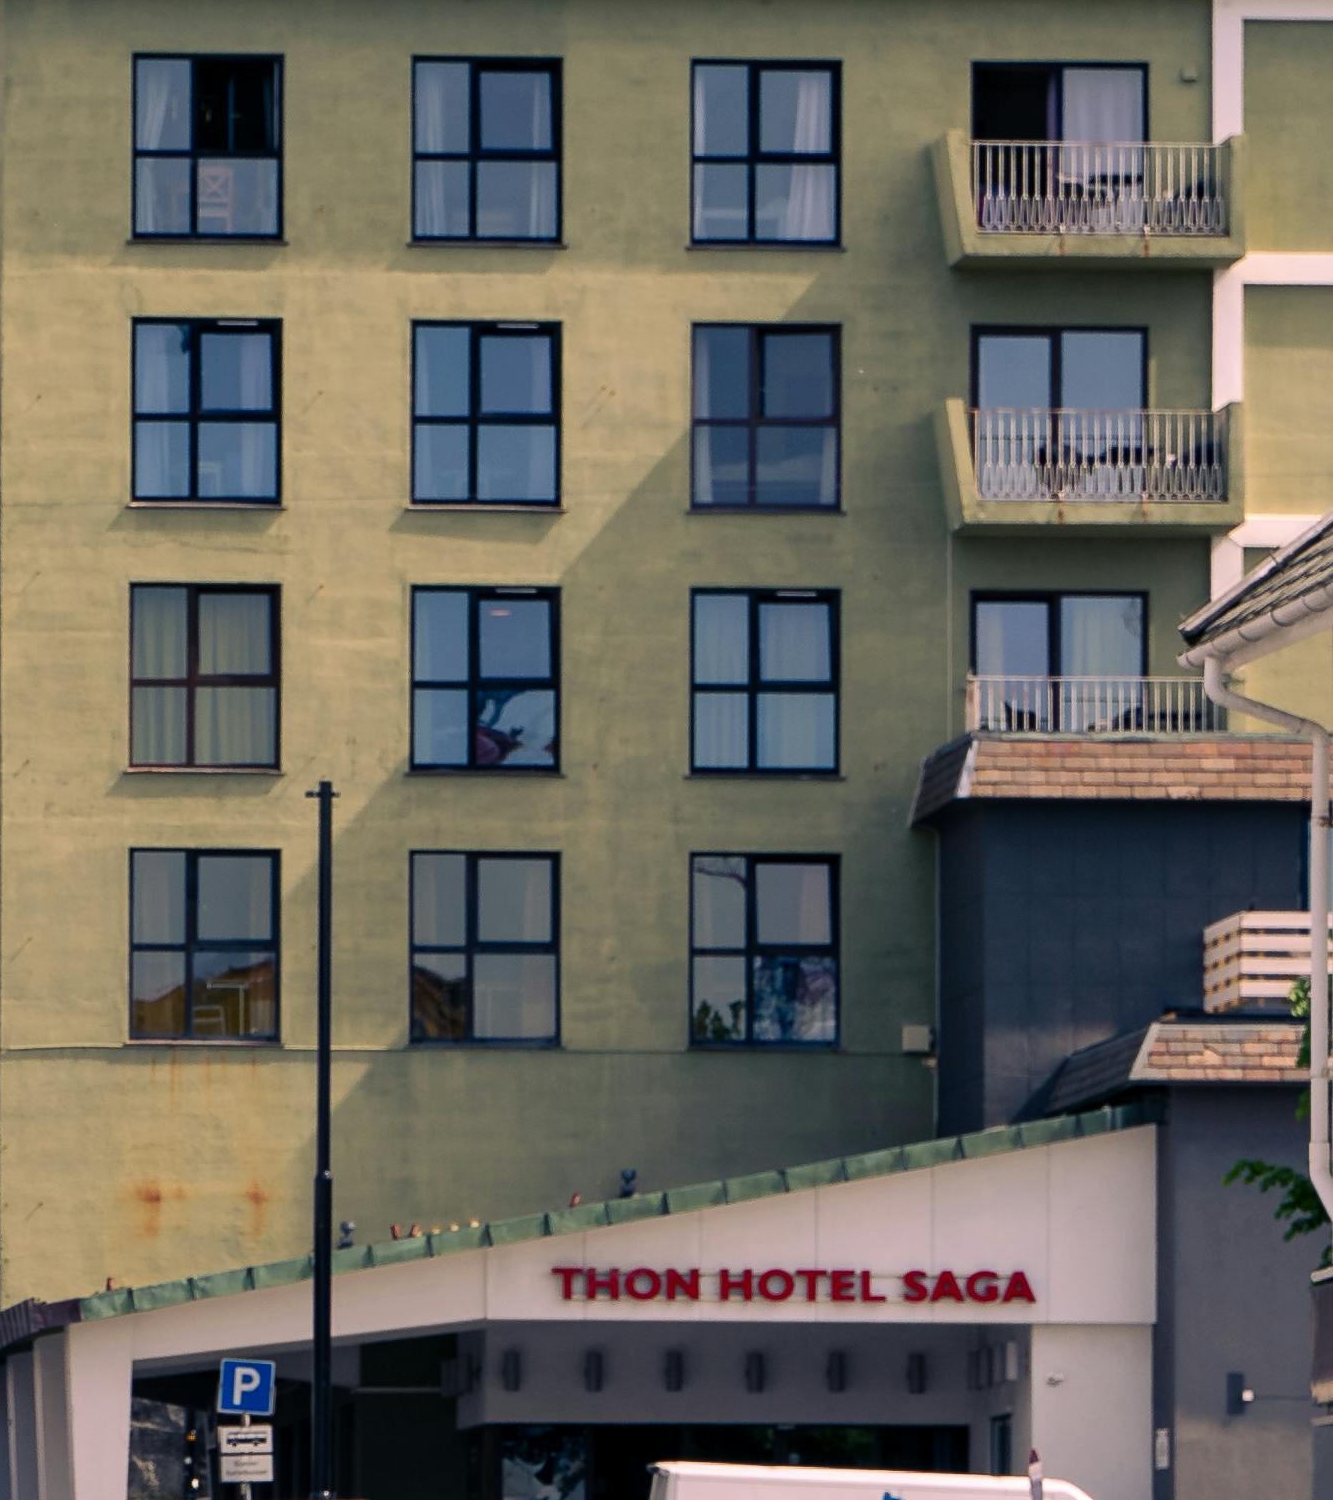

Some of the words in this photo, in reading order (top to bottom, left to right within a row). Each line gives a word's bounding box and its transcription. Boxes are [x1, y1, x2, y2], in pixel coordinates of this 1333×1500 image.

[552, 1268, 700, 1301] THON
[719, 1269, 886, 1302] HOTEL
[901, 1270, 1037, 1303] SAGA
[233, 1366, 261, 1406] P
